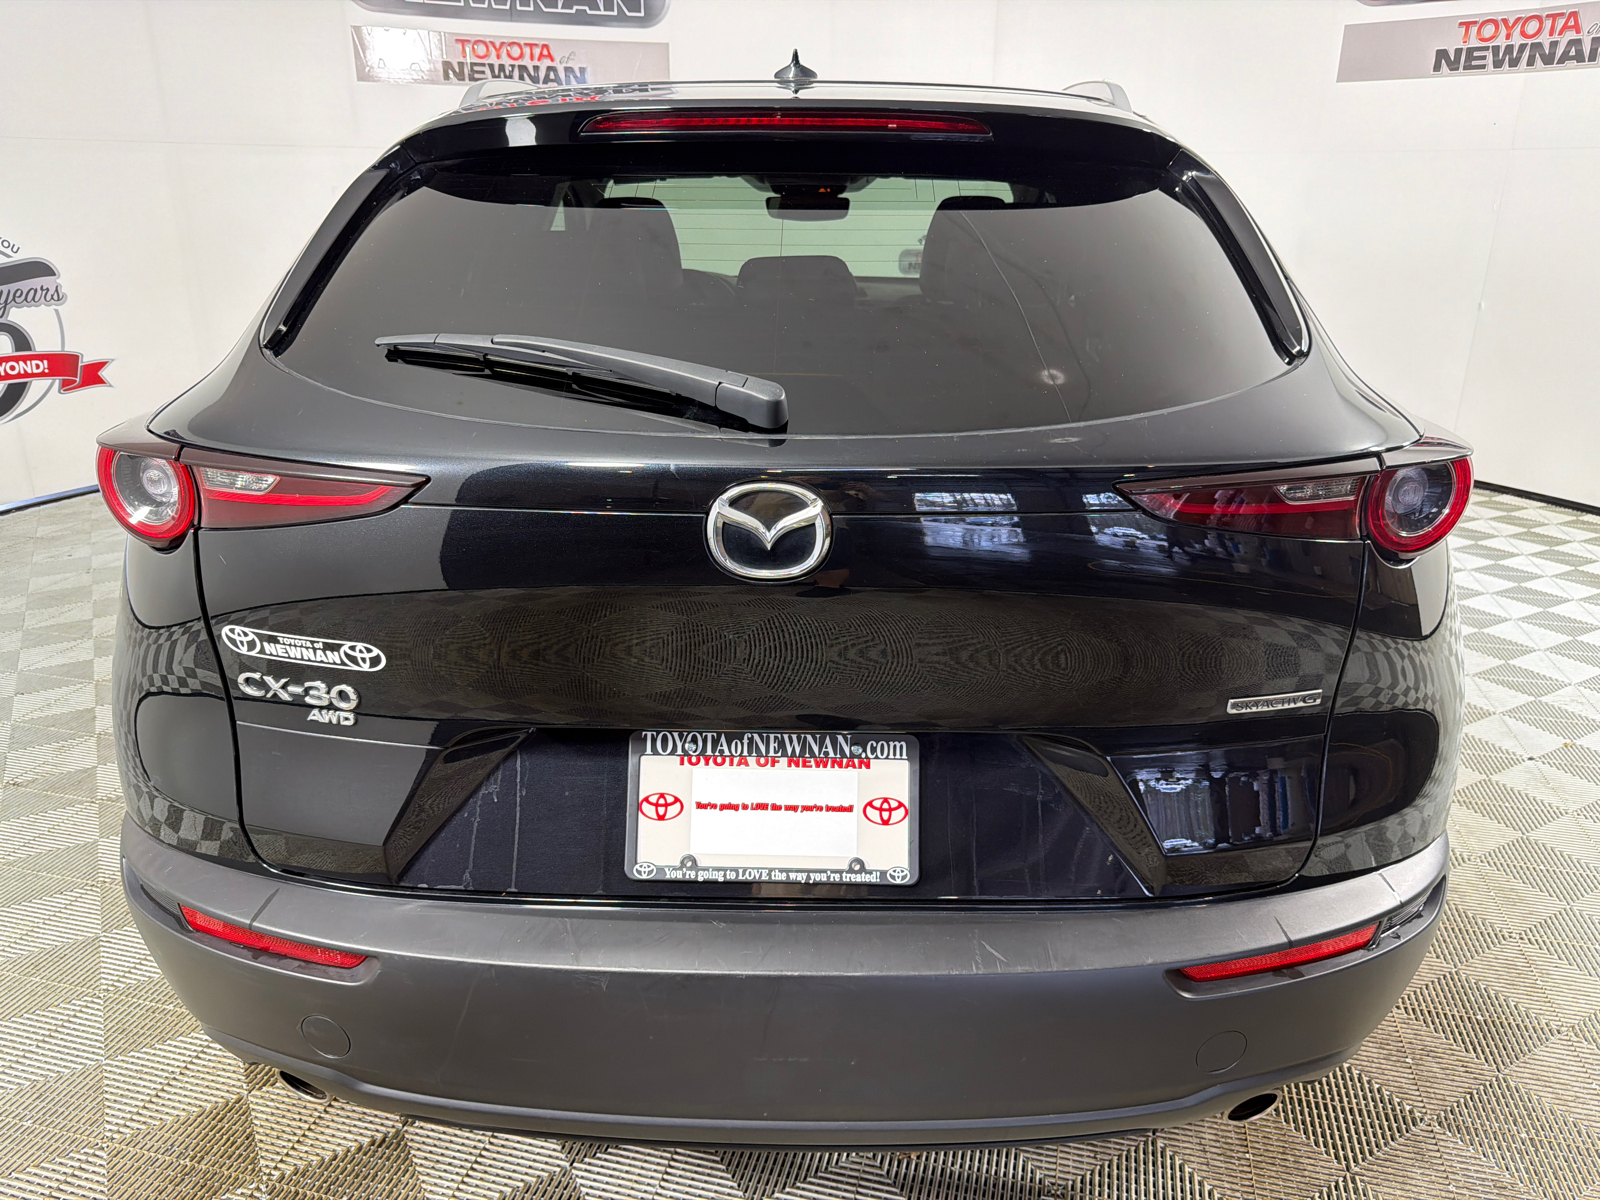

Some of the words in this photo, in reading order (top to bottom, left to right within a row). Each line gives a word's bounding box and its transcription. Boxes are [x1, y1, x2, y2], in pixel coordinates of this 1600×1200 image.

[1458, 10, 1583, 45] TOYOTA
[454, 38, 555, 63] TOYOTA
[559, 50, 577, 65] of
[441, 60, 588, 88] NEWNAN
[0, 284, 65, 319] years
[262, 641, 342, 665] NEWNAN
[277, 636, 312, 649] TOYOTA
[313, 641, 324, 650] of
[237, 671, 360, 711] CX-30
[306, 708, 358, 726] AWD
[664, 868, 696, 879] You're
[698, 871, 724, 882] going
[726, 871, 736, 880] to
[738, 870, 769, 880] LOVE
[770, 870, 787, 880] the
[788, 873, 808, 884] way
[809, 872, 840, 884] you're
[842, 872, 881, 883] treated!
